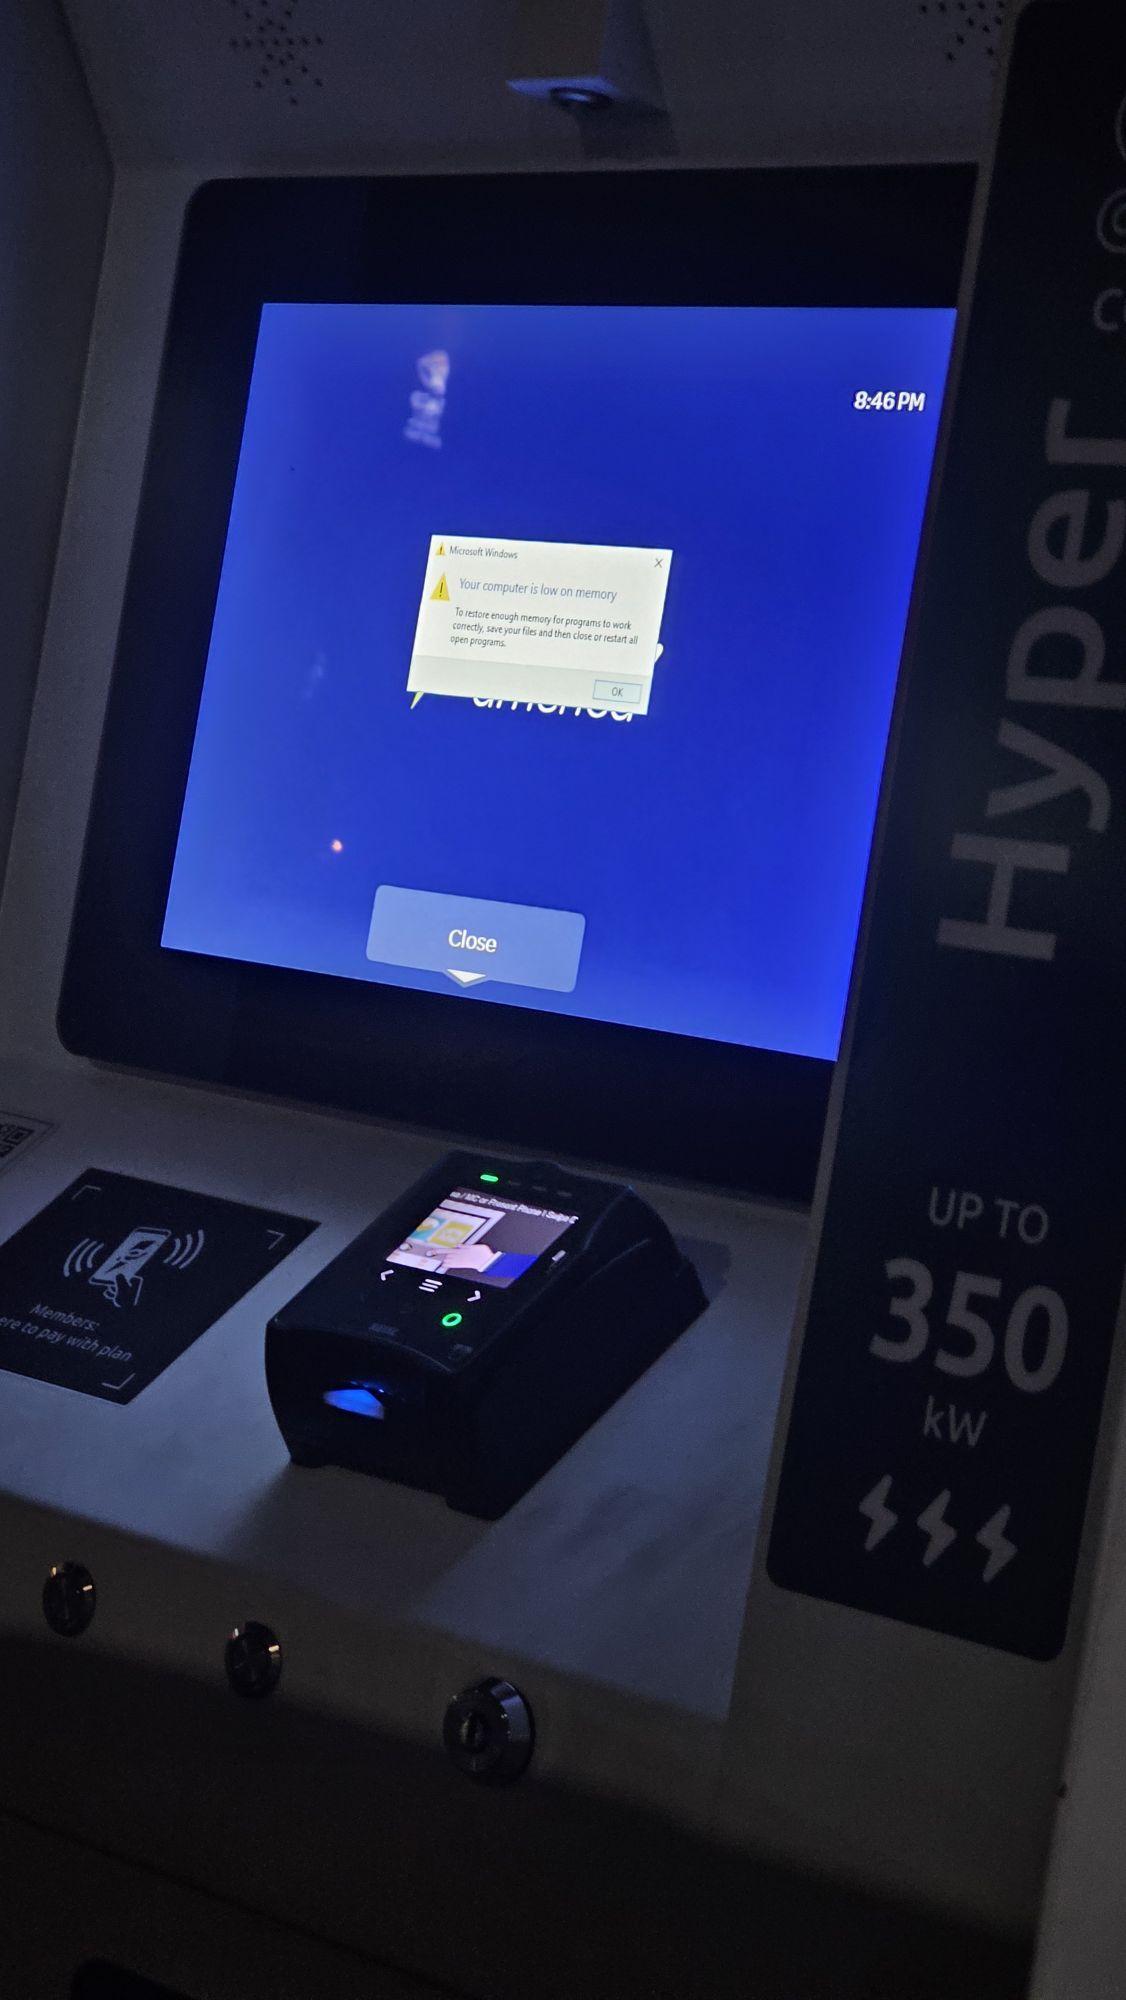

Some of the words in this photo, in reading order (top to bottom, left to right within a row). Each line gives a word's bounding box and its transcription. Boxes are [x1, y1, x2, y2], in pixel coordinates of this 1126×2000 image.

[853, 390, 896, 411] 8:46
[897, 391, 926, 412] PM
[449, 545, 484, 557] Microsoft
[485, 547, 518, 560] Windows
[459, 577, 481, 591] Your
[482, 580, 528, 596] computer
[529, 582, 538, 595] is
[540, 583, 558, 597] low
[559, 587, 573, 598] on
[575, 588, 618, 603] memory
[455, 606, 465, 618] To
[465, 609, 490, 620] restore
[490, 610, 519, 623] enough
[520, 614, 551, 625] memory
[552, 614, 564, 625] for
[564, 617, 602, 630] programs
[602, 618, 611, 629] to
[612, 619, 632, 631] work
[449, 635, 469, 648] open
[469, 637, 507, 649] programs.
[452, 622, 485, 634] correctly,
[486, 624, 503, 635] save
[503, 627, 522, 638] your
[522, 625, 538, 637] files
[538, 627, 553, 639] and
[554, 628, 571, 640] then
[573, 629, 592, 642] close
[593, 633, 602, 643] or
[603, 632, 628, 644] restart
[629, 634, 639, 646] all
[611, 686, 624, 698] OK
[935, 397, 1126, 962] Hyper
[448, 929, 498, 953] Close
[928, 1184, 986, 1230] UP
[994, 1198, 1051, 1246] TO
[868, 1255, 1071, 1394] 350
[20, 1321, 40, 1336] to
[34, 1327, 67, 1345] pay
[65, 1334, 100, 1353] with
[95, 1344, 133, 1362] plan
[922, 1394, 988, 1449] kW
